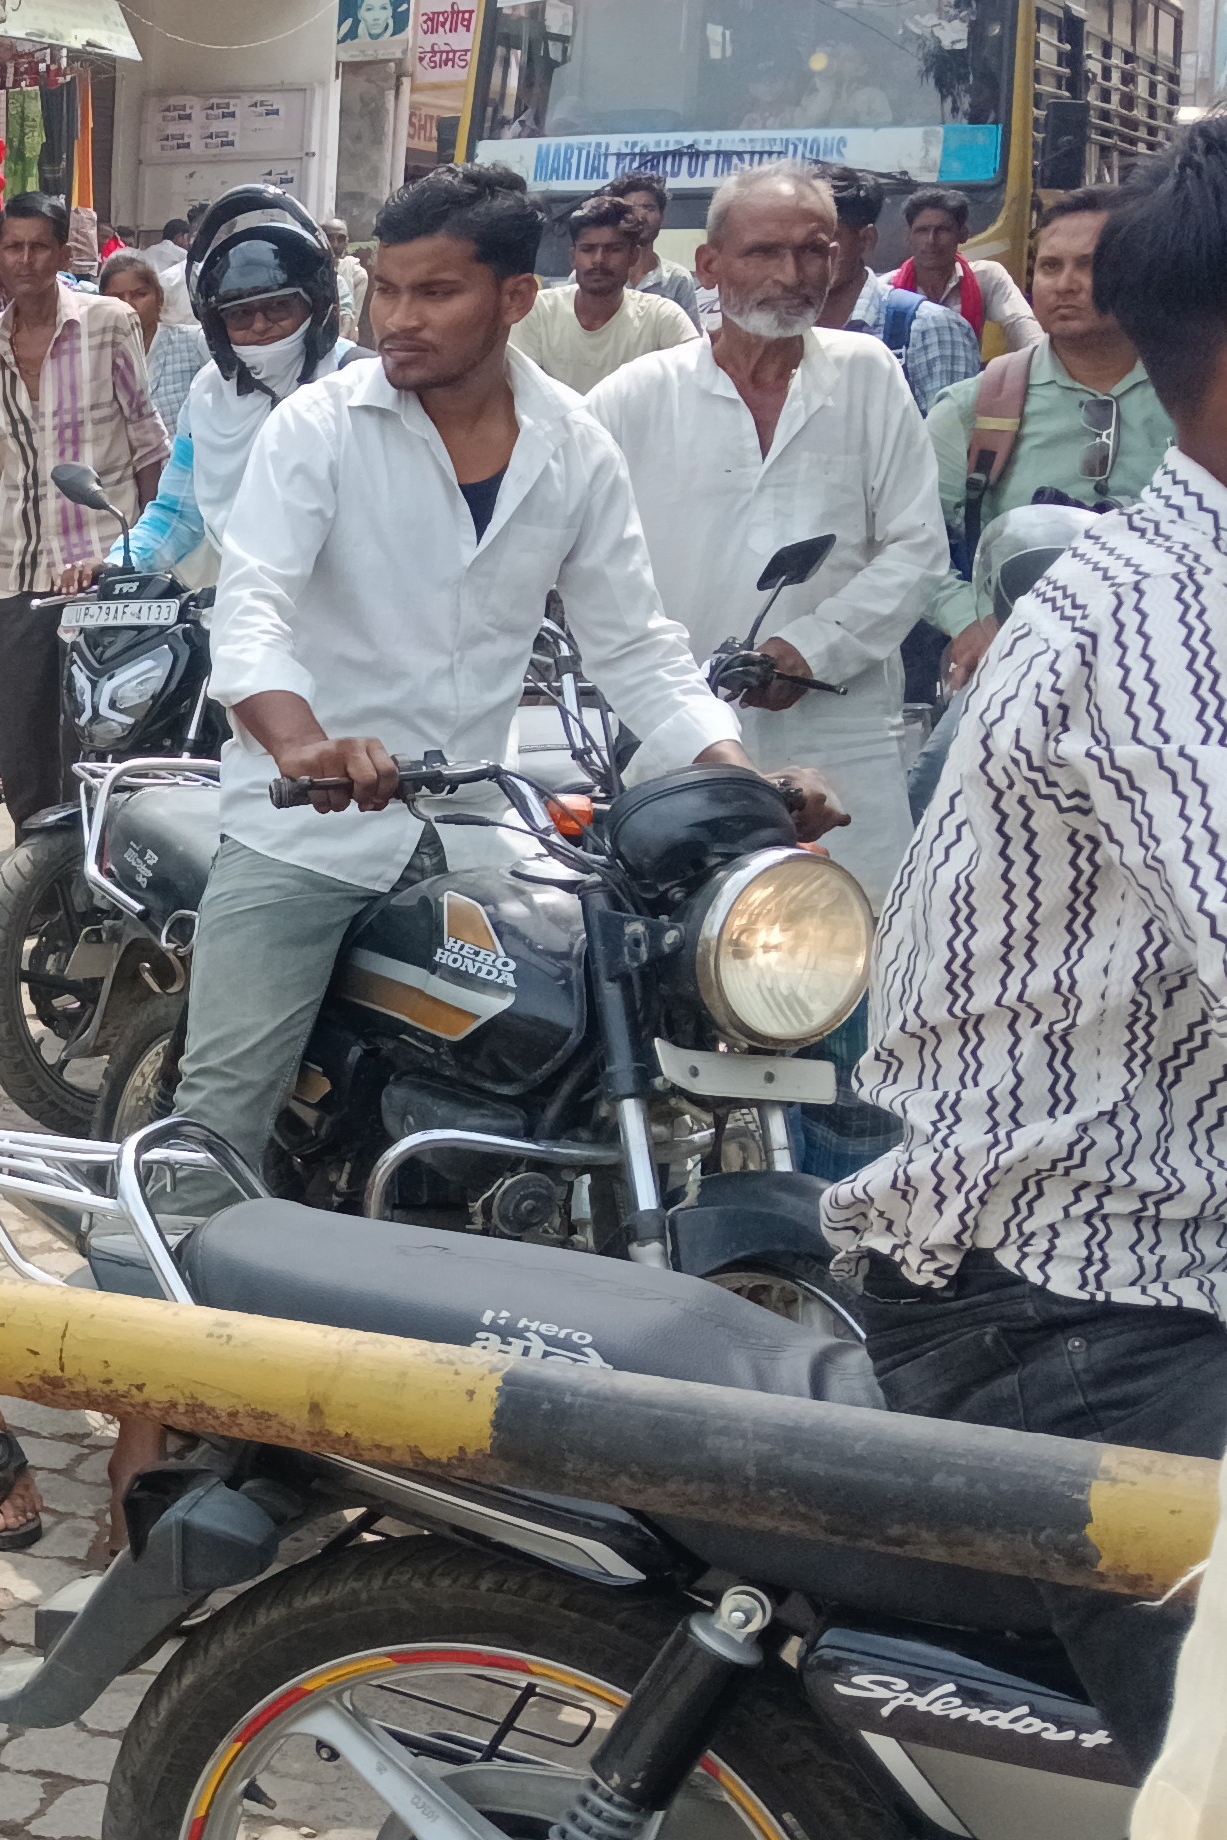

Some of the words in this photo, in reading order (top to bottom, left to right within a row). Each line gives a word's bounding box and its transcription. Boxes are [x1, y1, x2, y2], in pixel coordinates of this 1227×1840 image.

[420, 1, 475, 35] आशीष
[418, 42, 472, 70] रेडीमेड
[533, 141, 610, 182] MARTIAL
[113, 582, 140, 595] TVS
[433, 948, 518, 988] HONDA
[445, 937, 517, 972] HERO
[517, 1317, 593, 1345] Hero
